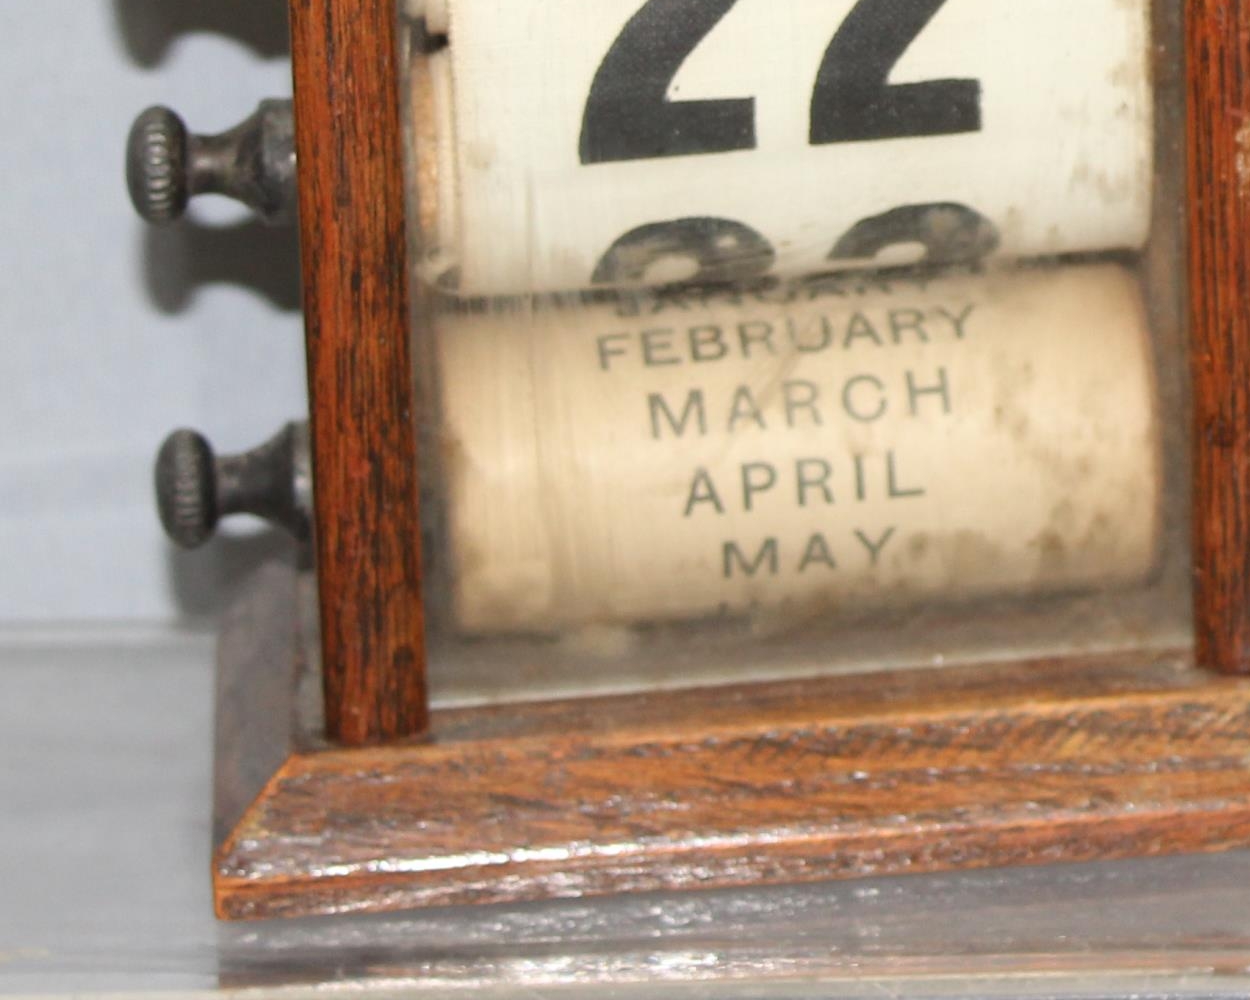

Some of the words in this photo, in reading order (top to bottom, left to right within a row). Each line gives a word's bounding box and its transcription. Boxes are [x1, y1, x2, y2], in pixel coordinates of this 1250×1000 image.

[596, 304, 975, 371] FEBRUARY
[646, 366, 953, 440] MARCH
[682, 448, 926, 518] APRIL
[722, 526, 896, 579] MAY
